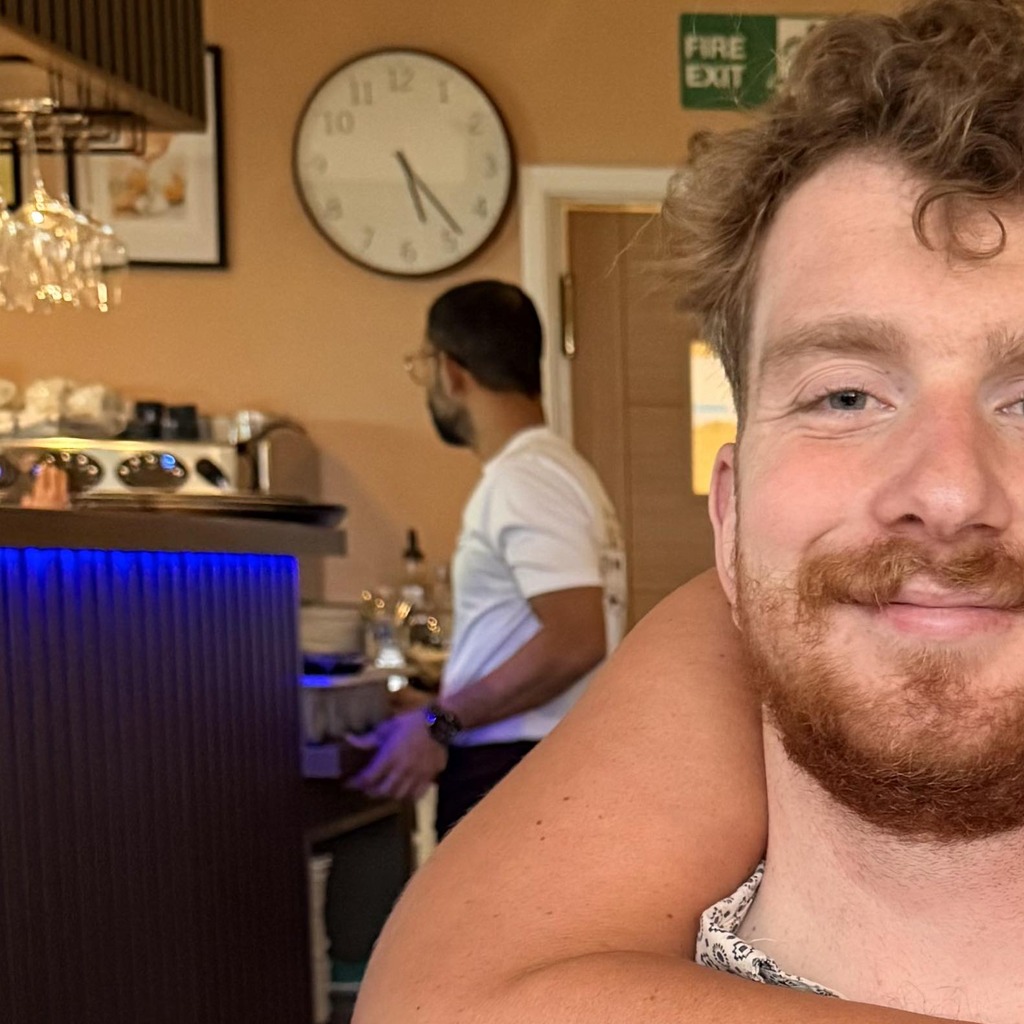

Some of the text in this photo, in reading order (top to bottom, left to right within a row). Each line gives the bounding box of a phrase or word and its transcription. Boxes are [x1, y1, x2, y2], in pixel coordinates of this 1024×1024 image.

[684, 35, 746, 60] FIRE
[387, 67, 415, 93] 12
[685, 65, 744, 88] EXIT
[350, 75, 373, 105] 11
[438, 80, 449, 104] 1
[322, 110, 355, 135] 10
[469, 111, 485, 135] 2
